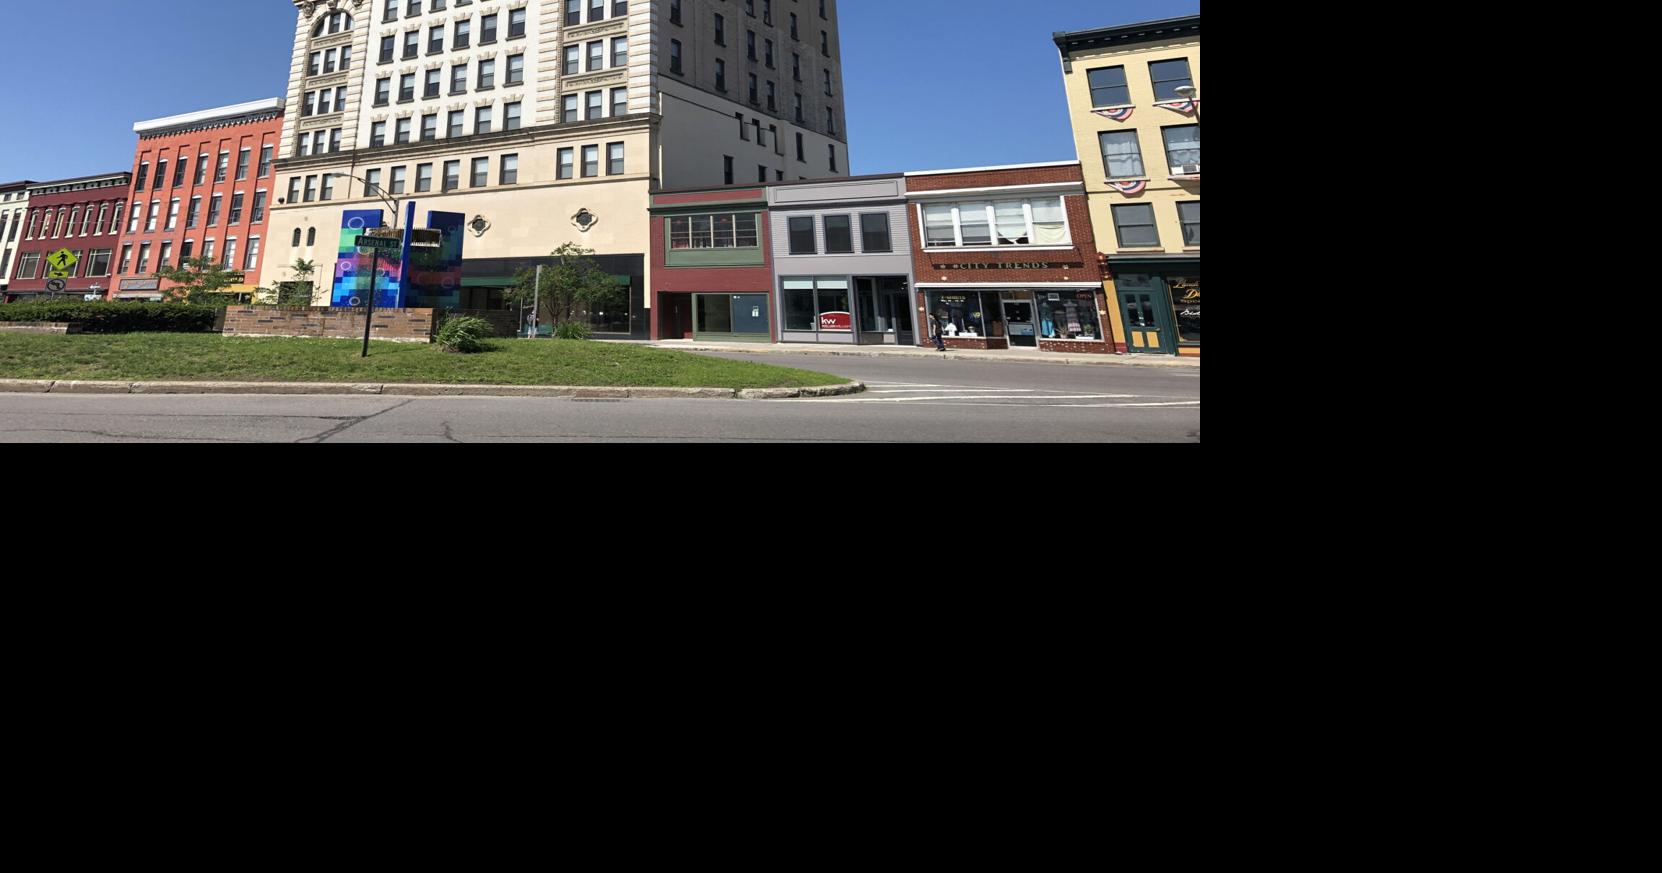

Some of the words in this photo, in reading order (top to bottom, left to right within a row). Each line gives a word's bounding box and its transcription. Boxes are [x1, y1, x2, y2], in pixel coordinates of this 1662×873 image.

[357, 237, 386, 247] ARSENAL
[959, 262, 989, 270] CITY
[997, 261, 1049, 269] TRENDS
[820, 316, 837, 325] kw
